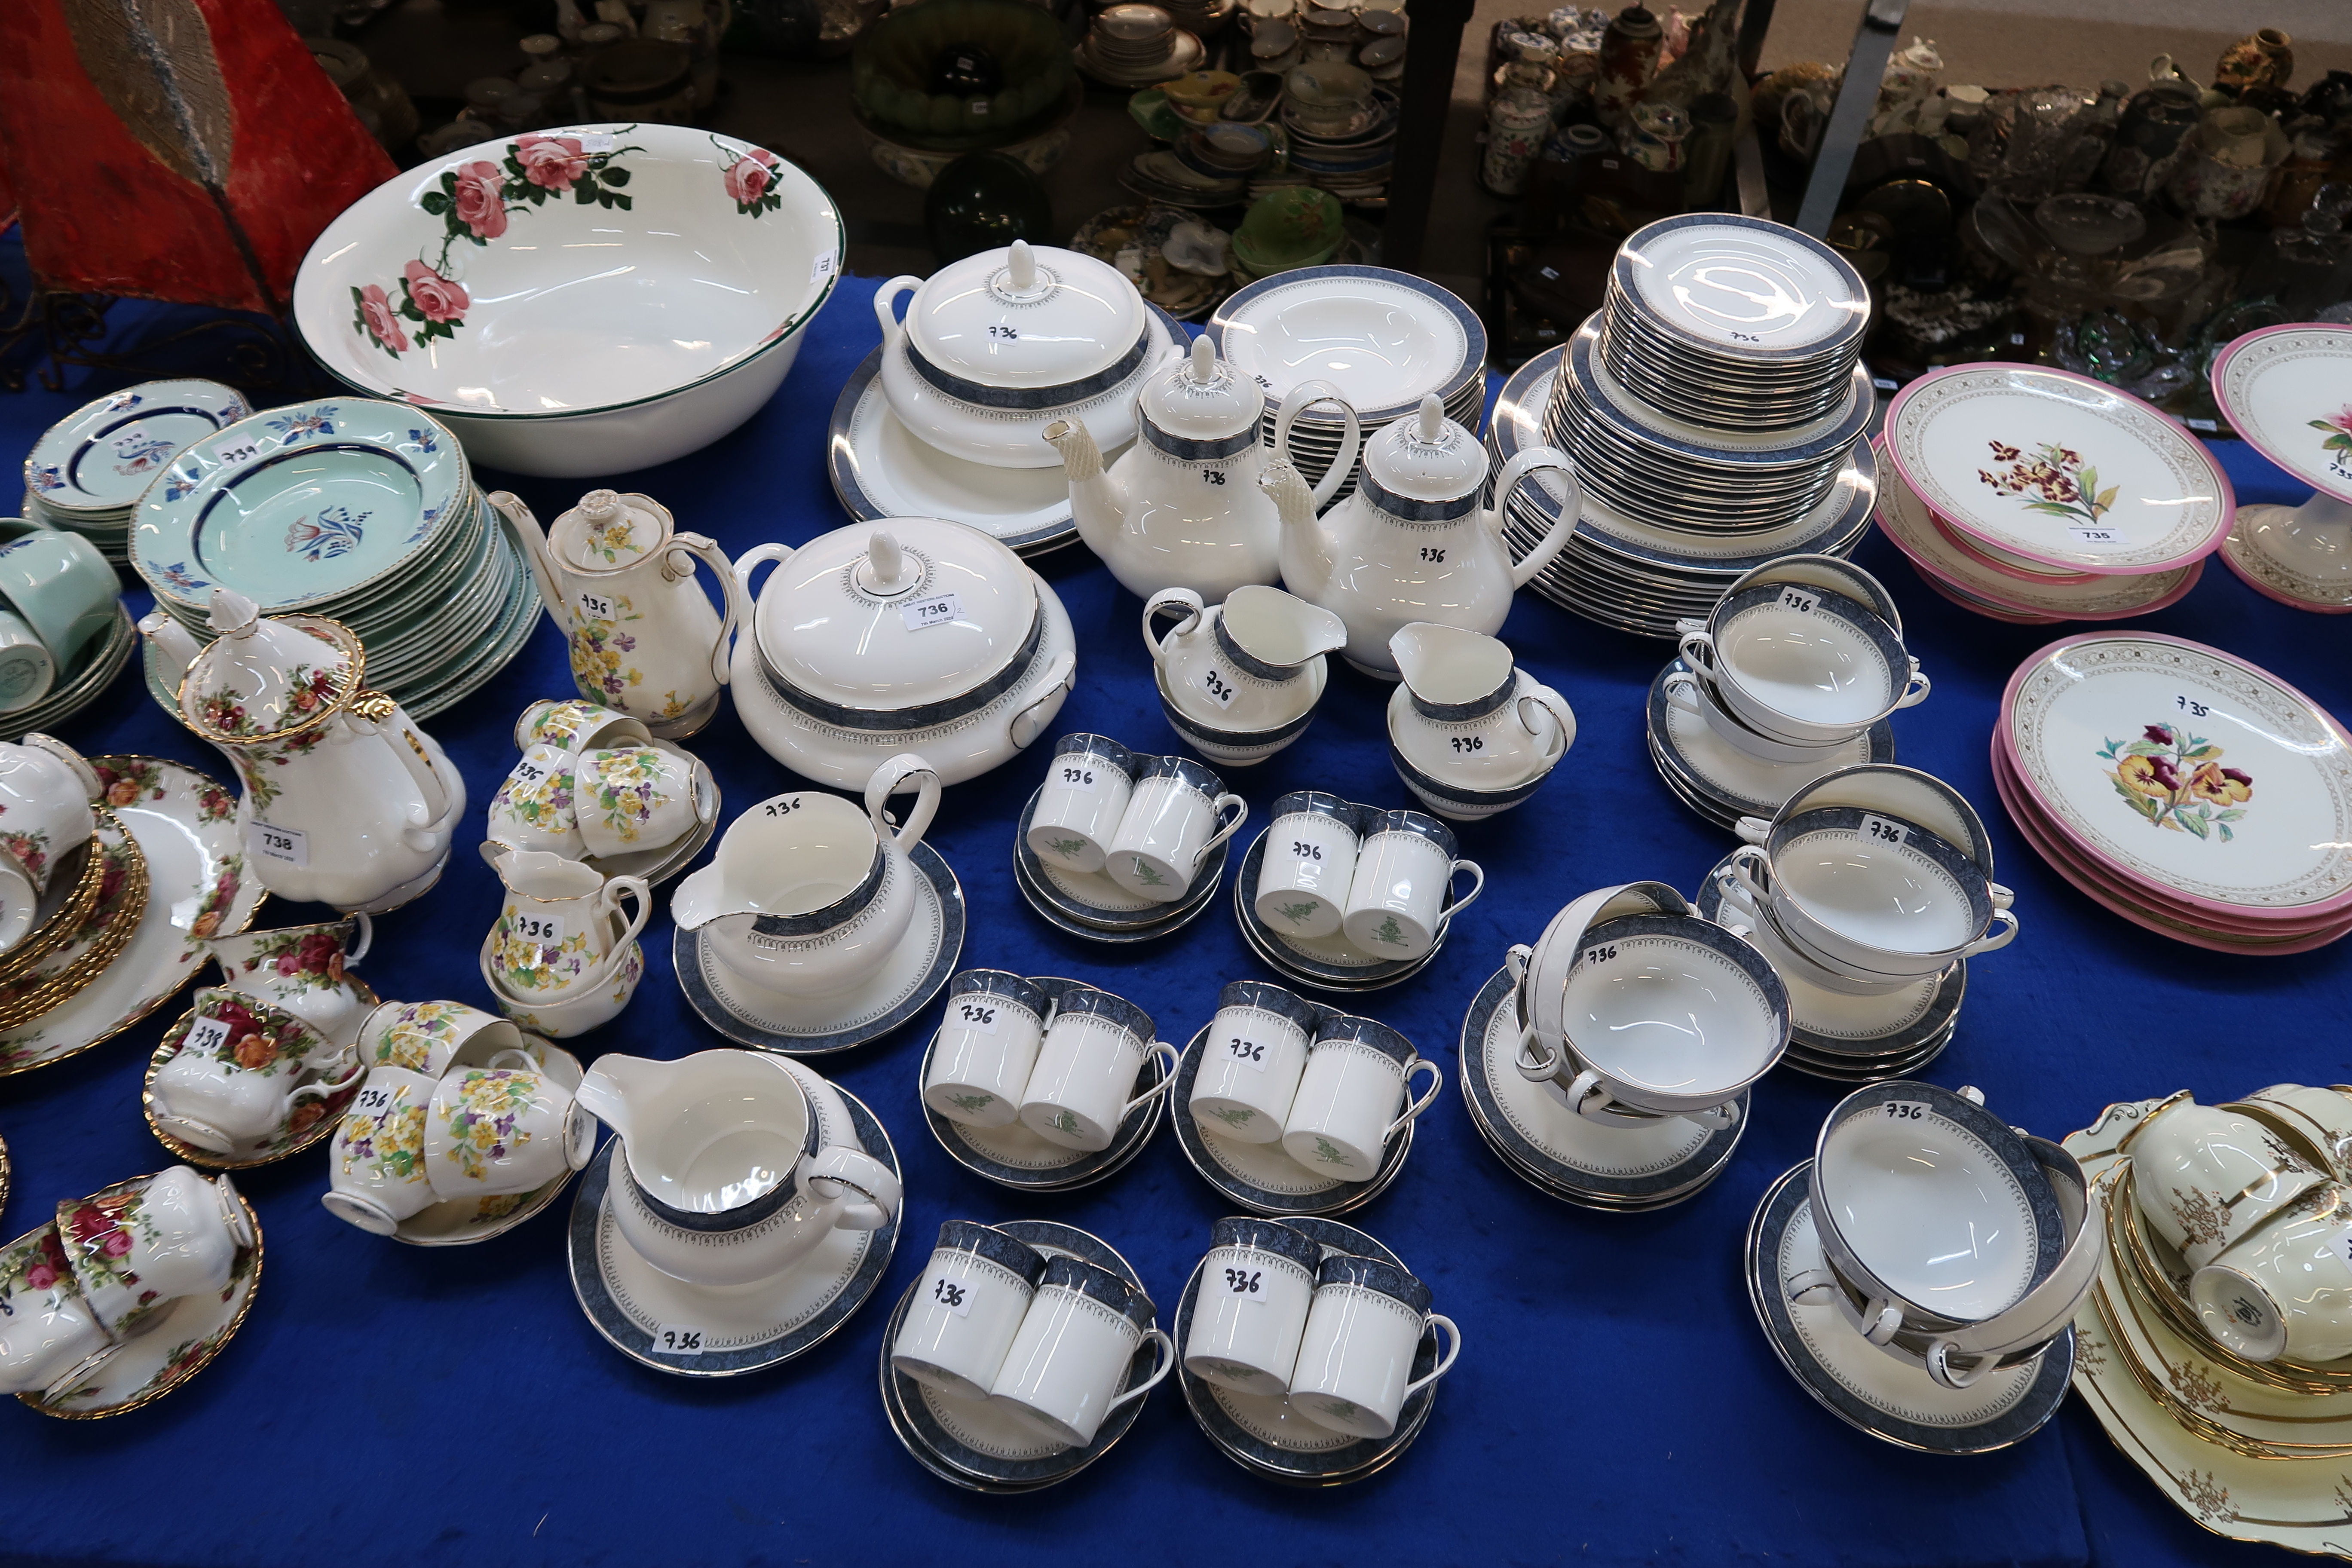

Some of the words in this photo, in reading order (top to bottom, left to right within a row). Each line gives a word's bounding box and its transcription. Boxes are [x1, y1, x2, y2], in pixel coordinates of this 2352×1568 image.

[989, 326, 1017, 339] 736
[1729, 332, 1759, 342] 736
[1254, 375, 1273, 388] 736
[113, 433, 142, 447] 739
[221, 445, 258, 463] 739
[1203, 469, 1225, 485] 736
[1420, 547, 1446, 563] 736
[582, 594, 606, 614] 736
[917, 603, 948, 617] 736
[1785, 593, 1811, 612] 736
[1207, 671, 1232, 701] 736
[2177, 696, 2209, 717] 735
[1451, 736, 1483, 753] 736
[516, 763, 544, 781] 736
[1064, 769, 1093, 784] 736
[766, 797, 800, 817] 736
[1870, 821, 1899, 842] 736
[263, 833, 292, 850] 738
[1293, 841, 1321, 860] 736
[519, 916, 552, 938] 736
[1588, 946, 1617, 965] 736
[961, 1005, 995, 1024] 736
[1230, 1038, 1265, 1062] 736
[359, 1090, 389, 1107] 736
[1886, 1103, 1922, 1120] 736
[1225, 1268, 1261, 1293] 736
[935, 1279, 966, 1307] 736
[664, 1331, 701, 1350] 736
